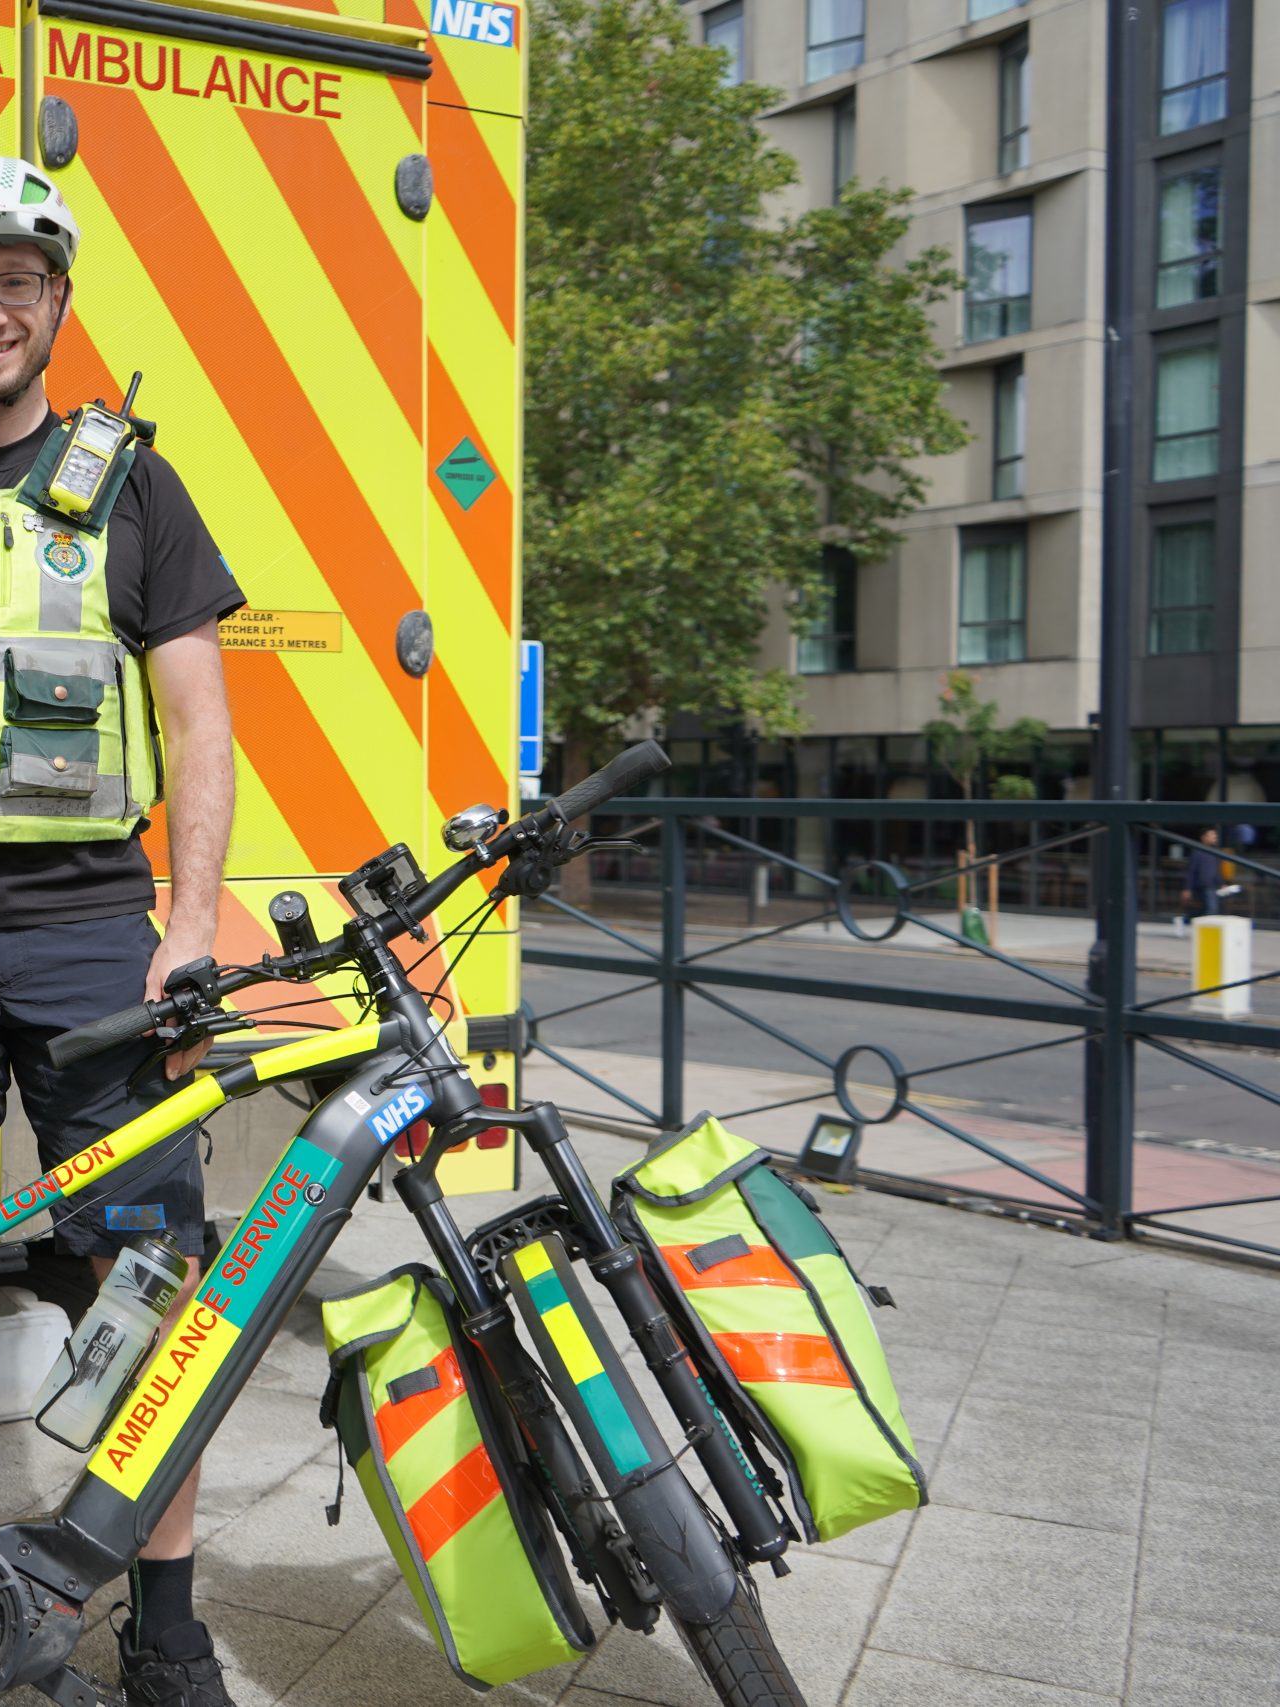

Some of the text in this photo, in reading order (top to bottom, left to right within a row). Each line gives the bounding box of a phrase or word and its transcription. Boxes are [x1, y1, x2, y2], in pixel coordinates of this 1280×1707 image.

[431, 0, 513, 44] NHS
[49, 28, 342, 119] MBULANCE
[219, 625, 284, 635] ETCHER LIFT
[240, 612, 273, 622] CLEAR
[220, 638, 327, 649] EARANCE 3.5 METRES
[371, 1086, 425, 1142] NHS
[107, 1163, 311, 1473] AMBULANCE SERVICE
